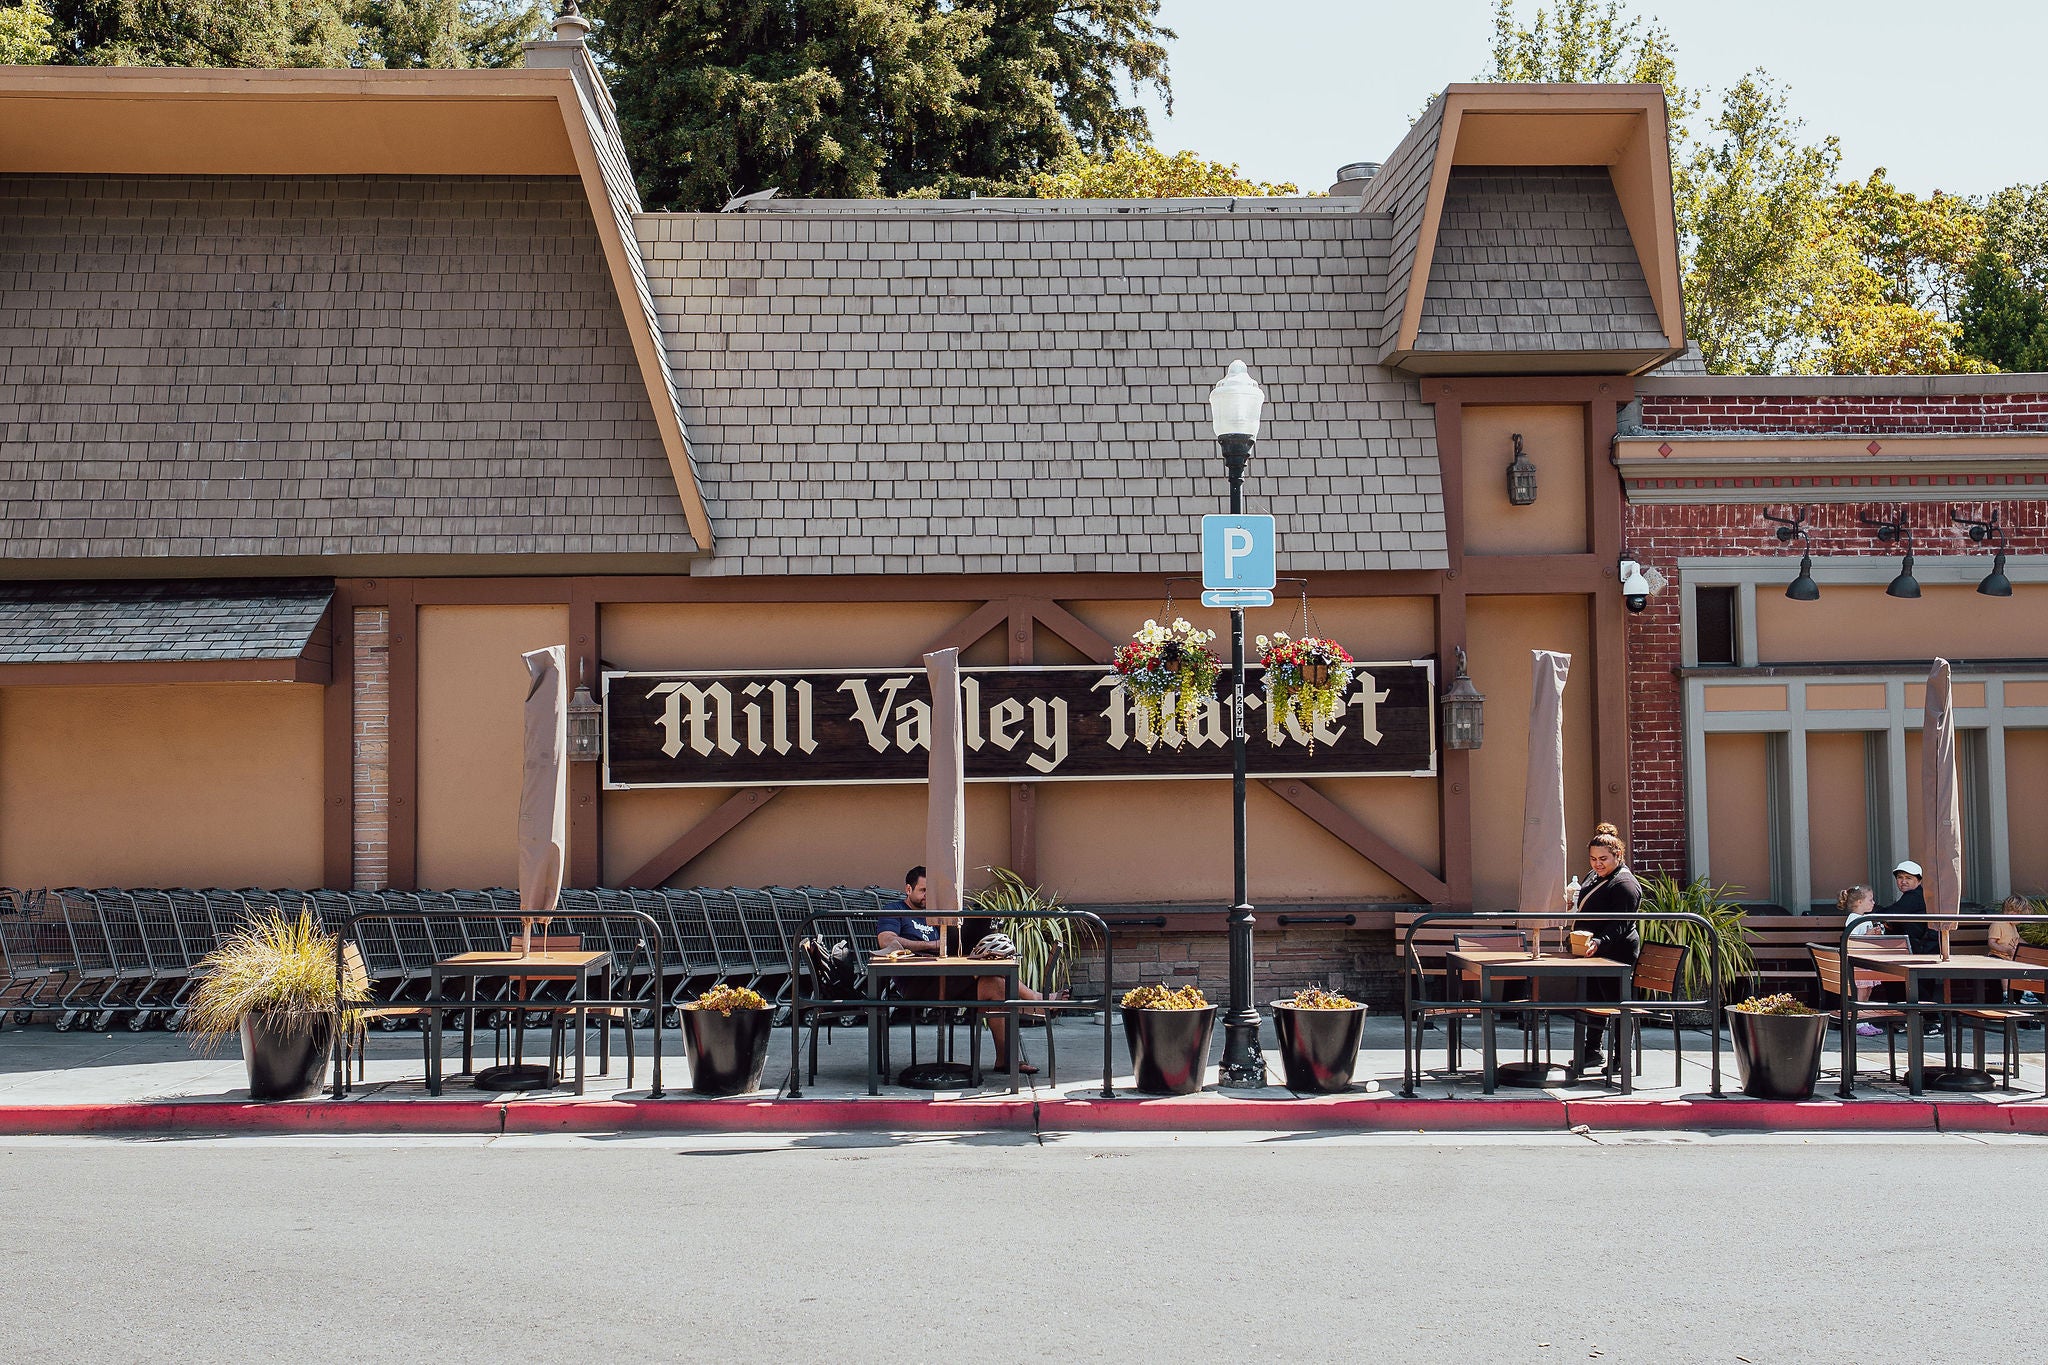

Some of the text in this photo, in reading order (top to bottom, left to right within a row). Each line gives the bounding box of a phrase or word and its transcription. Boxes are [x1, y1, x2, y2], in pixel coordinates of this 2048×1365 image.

[1223, 527, 1254, 579] P
[645, 680, 819, 759] Mill
[836, 675, 1069, 774] Valey
[1235, 684, 1244, 737] 1237H
